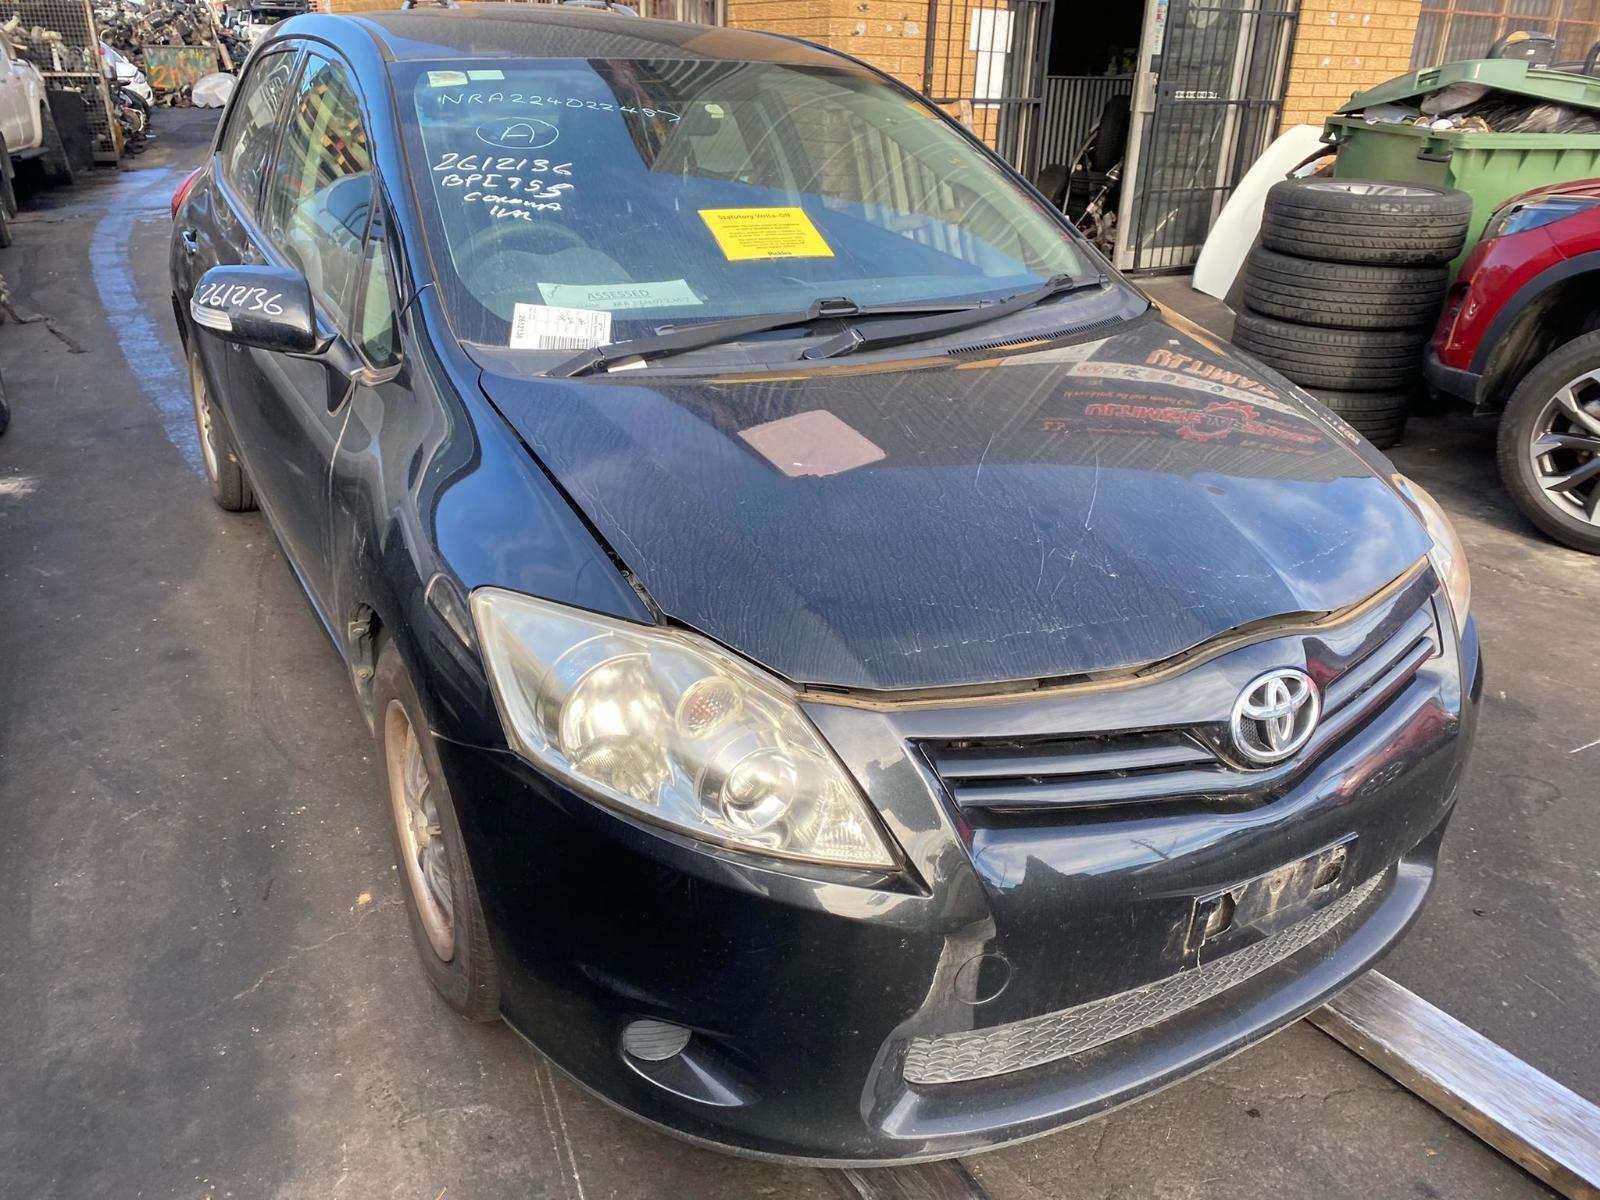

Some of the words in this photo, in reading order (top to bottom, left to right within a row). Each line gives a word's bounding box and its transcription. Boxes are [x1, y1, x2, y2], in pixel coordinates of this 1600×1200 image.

[433, 153, 573, 176] 2612136
[199, 283, 283, 315] 2612136
[588, 289, 649, 300] ASSESSED
